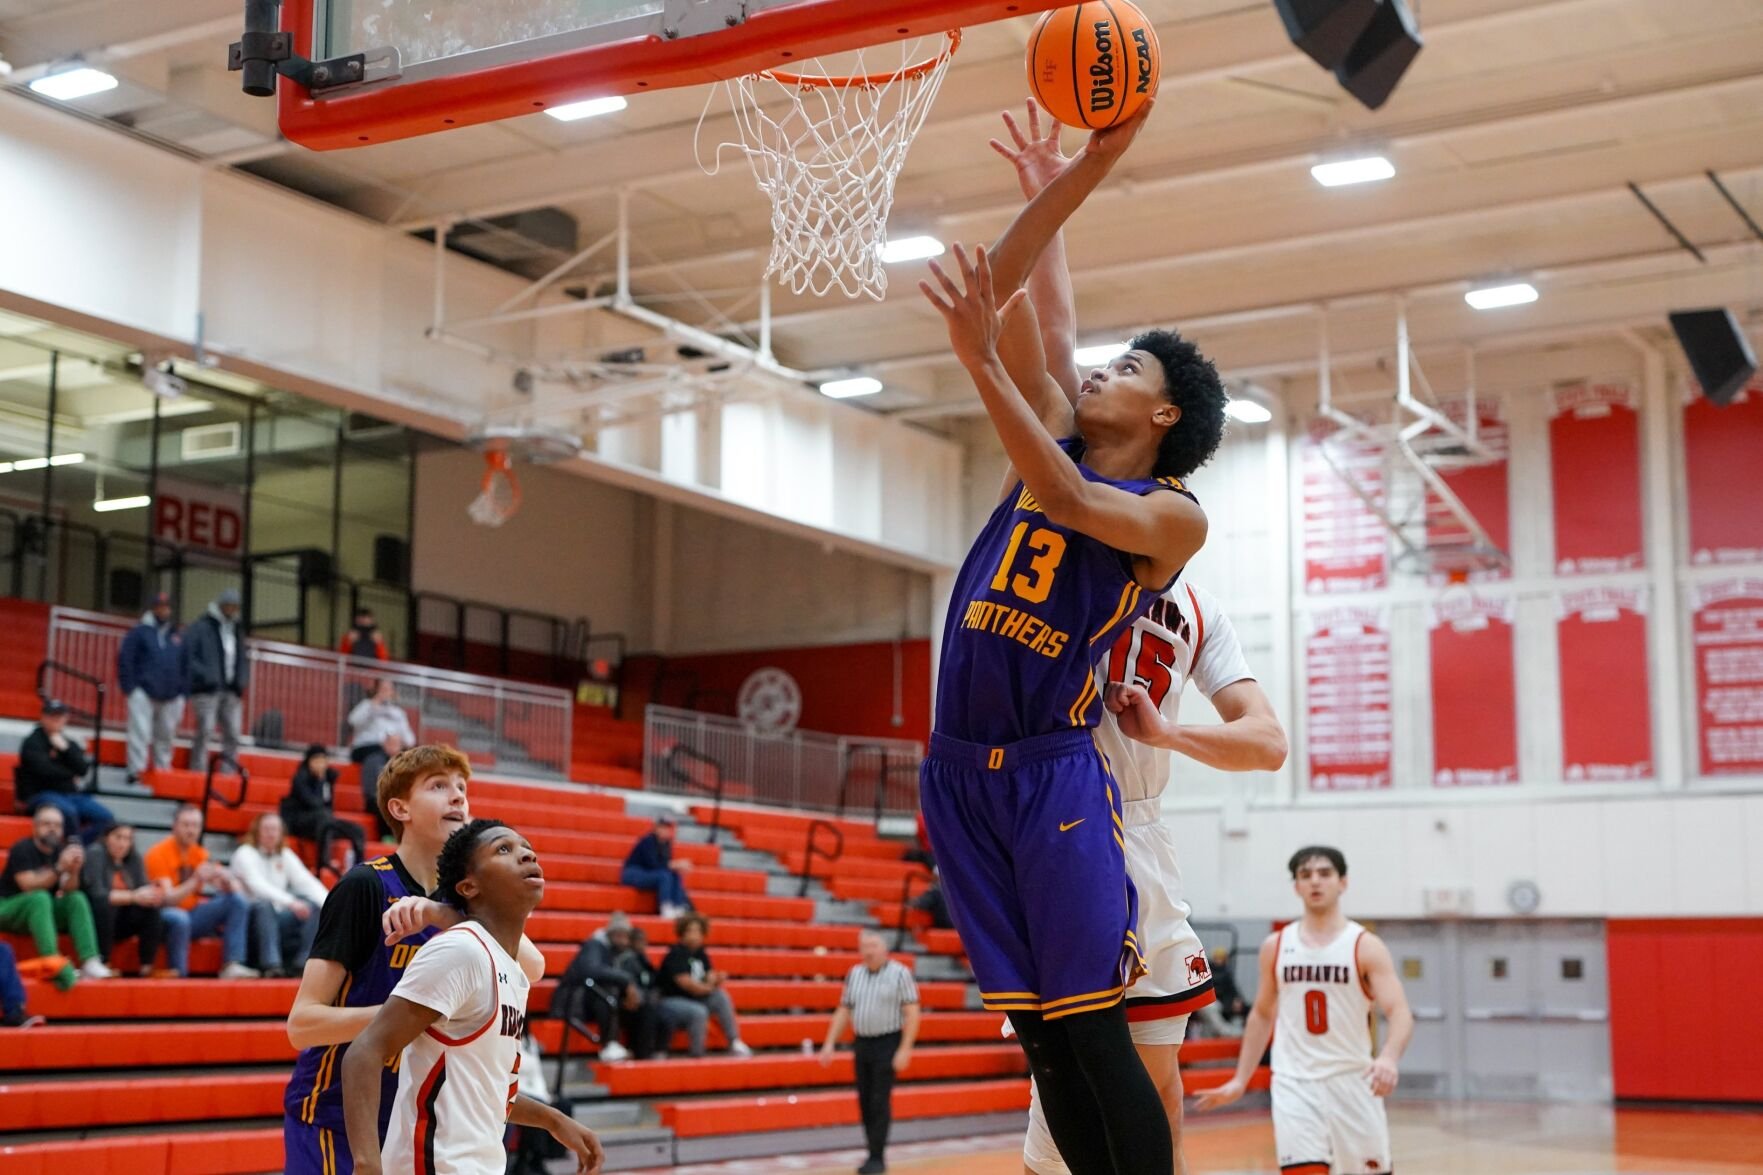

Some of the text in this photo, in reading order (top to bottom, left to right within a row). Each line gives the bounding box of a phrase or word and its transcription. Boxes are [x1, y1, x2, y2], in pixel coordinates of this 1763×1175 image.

[1090, 20, 1114, 112] Wilson
[1132, 28, 1152, 93] NCAA
[155, 494, 240, 550] RED
[990, 521, 1067, 604] 13
[961, 600, 1070, 659] PANTHERS
[1103, 626, 1176, 715] 15
[1305, 989, 1329, 1035] 0
